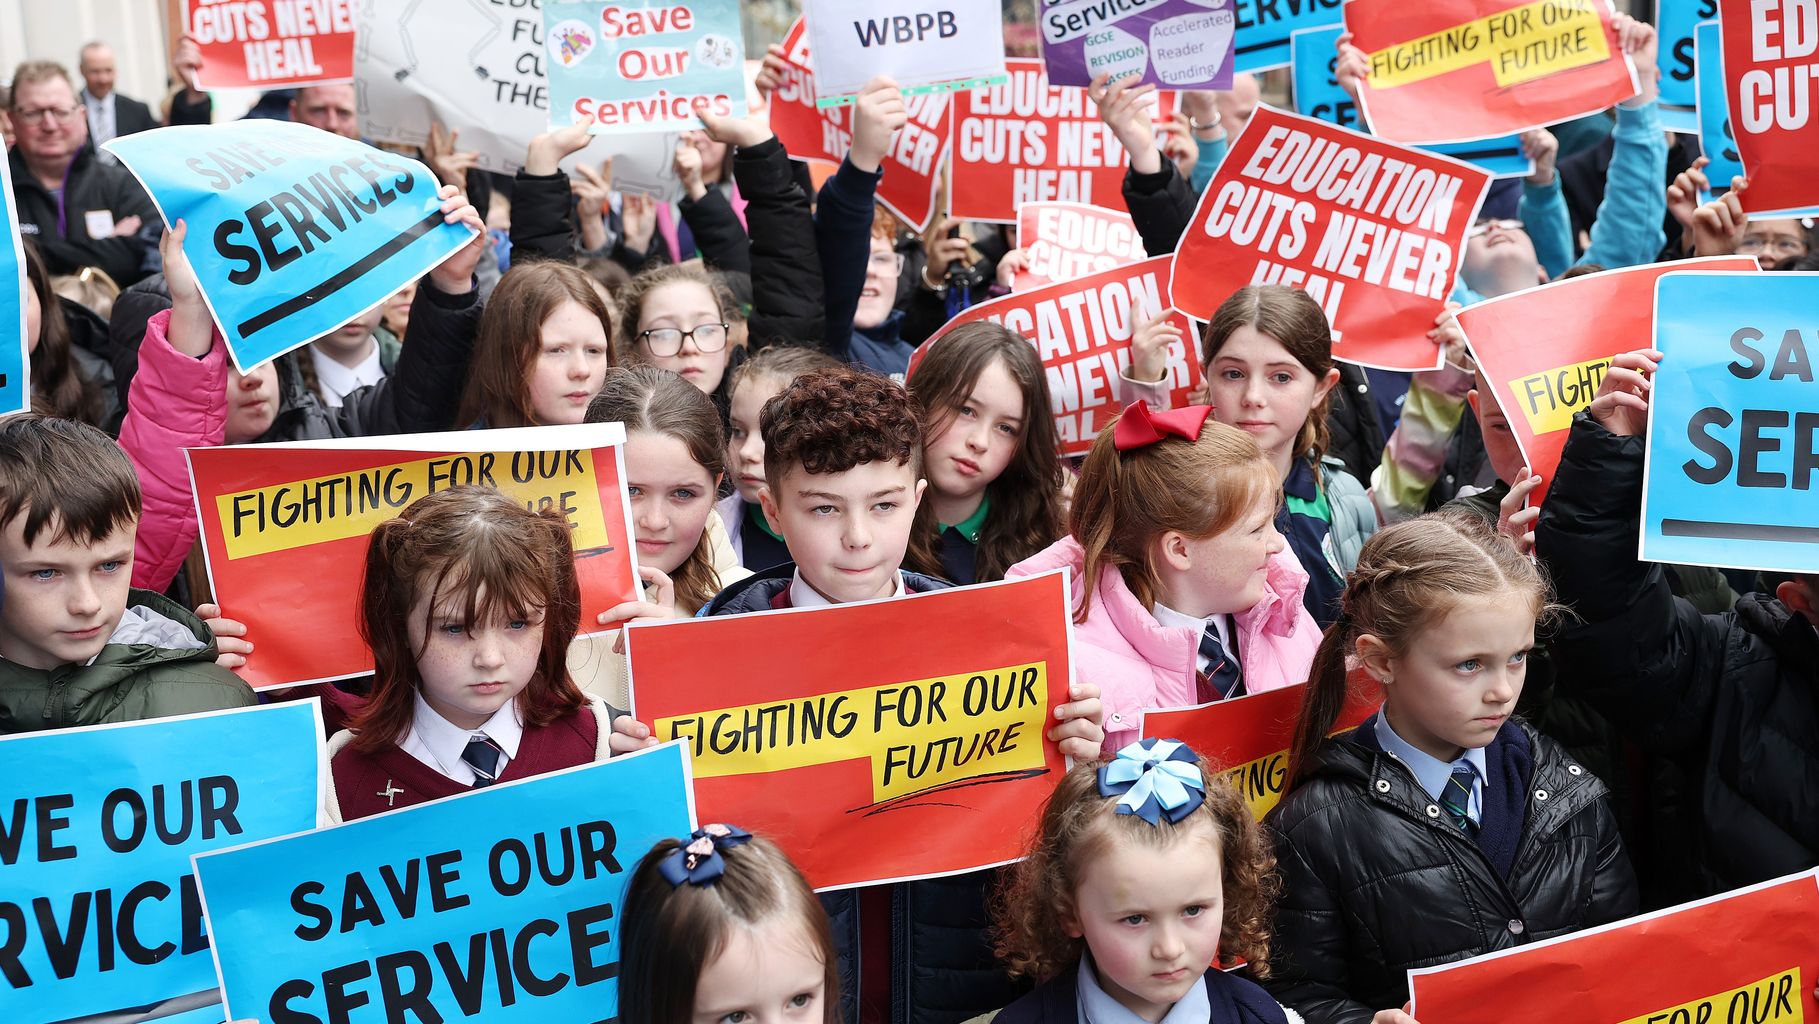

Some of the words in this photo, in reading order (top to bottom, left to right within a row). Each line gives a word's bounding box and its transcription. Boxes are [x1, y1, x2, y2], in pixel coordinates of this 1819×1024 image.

[193, 2, 270, 45] CUTS
[272, 0, 356, 38] NEVE
[602, 6, 692, 38] Save
[854, 11, 958, 47] WBPB
[1086, 31, 1115, 46] GCSE
[1153, 13, 1232, 39] Accelerated
[1371, 25, 1480, 78] FIGHTING
[1489, 8, 1533, 44] FOR
[1750, 0, 1819, 62] ED
[243, 38, 323, 81] HEAL
[619, 50, 689, 80] Our
[1090, 45, 1145, 68] REVISION
[1157, 42, 1206, 61] Reader
[1161, 62, 1216, 83] Funding
[1500, 27, 1588, 75] FUTURE
[575, 90, 730, 125] Services
[1740, 64, 1819, 134] CU
[185, 141, 287, 191] SAVE
[960, 117, 1048, 166] CUTS
[1057, 121, 1168, 168] NEV
[1241, 124, 1463, 235] EDUCATION
[213, 153, 415, 286] SERVICES
[1037, 208, 1148, 260] EDUC
[1204, 180, 1317, 260] CUTS
[1312, 210, 1453, 300] NEVER
[978, 272, 1163, 362] CATION
[1046, 337, 1190, 414] NEVR
[1727, 327, 1819, 382] SA
[1523, 360, 1611, 415] FIGHT
[232, 468, 412, 538] FIGHTING
[428, 452, 497, 494] FOR
[512, 450, 585, 483] OUR
[671, 696, 858, 757] FIGHTING
[874, 681, 948, 733] FOR
[962, 667, 1038, 716] OUR
[883, 722, 1025, 787] FUTURE
[0, 794, 77, 865] VE
[101, 775, 243, 853] OUR
[290, 849, 471, 941] SAVE
[488, 820, 623, 897] OUR
[269, 903, 621, 1024] SERVICE
[1727, 974, 1793, 1024] OUR
